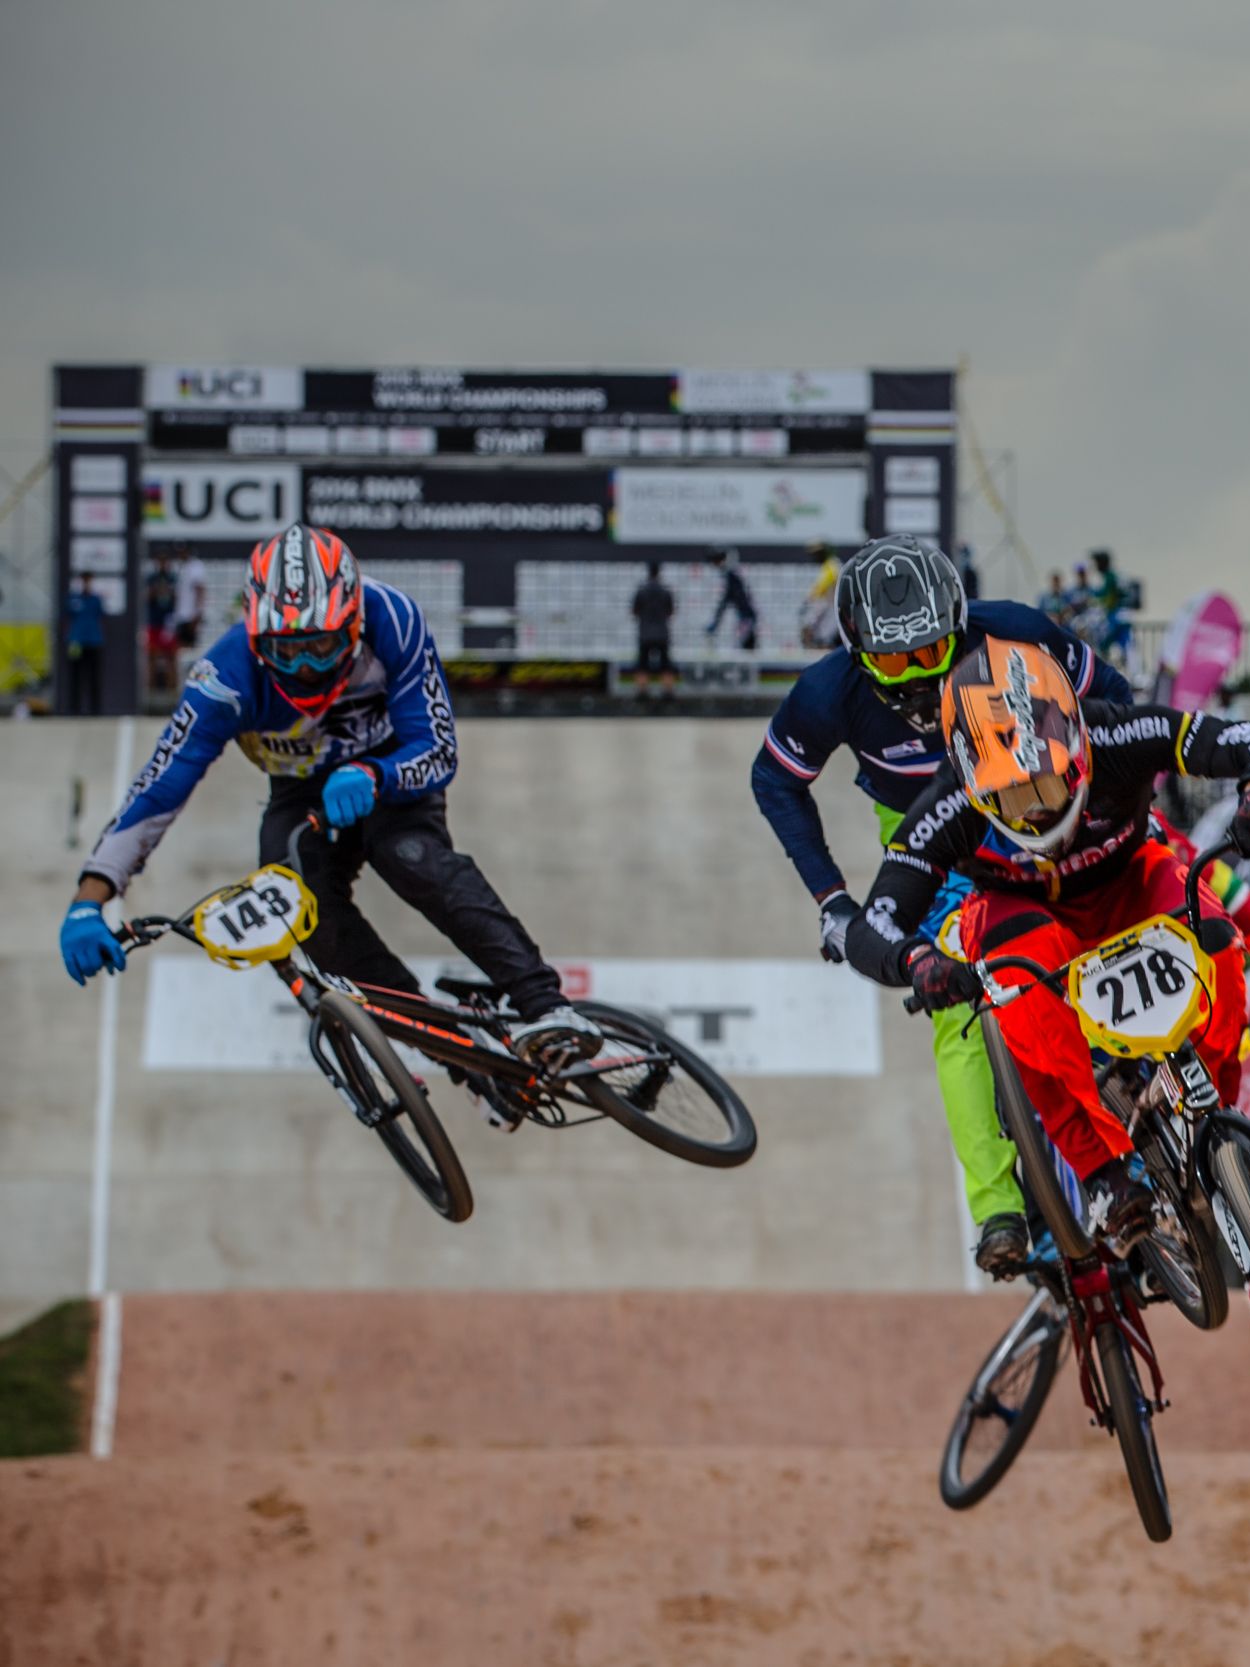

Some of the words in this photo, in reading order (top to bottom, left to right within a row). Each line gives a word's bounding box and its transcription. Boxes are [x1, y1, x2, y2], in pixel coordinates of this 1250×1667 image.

[193, 370, 263, 399] UCI
[173, 480, 283, 523] UCI
[308, 502, 399, 530] WORLD
[401, 503, 604, 531] CHAMPIONSHIPS
[908, 788, 970, 851] COLOM
[218, 887, 292, 943] 143
[1096, 950, 1186, 1027] 278
